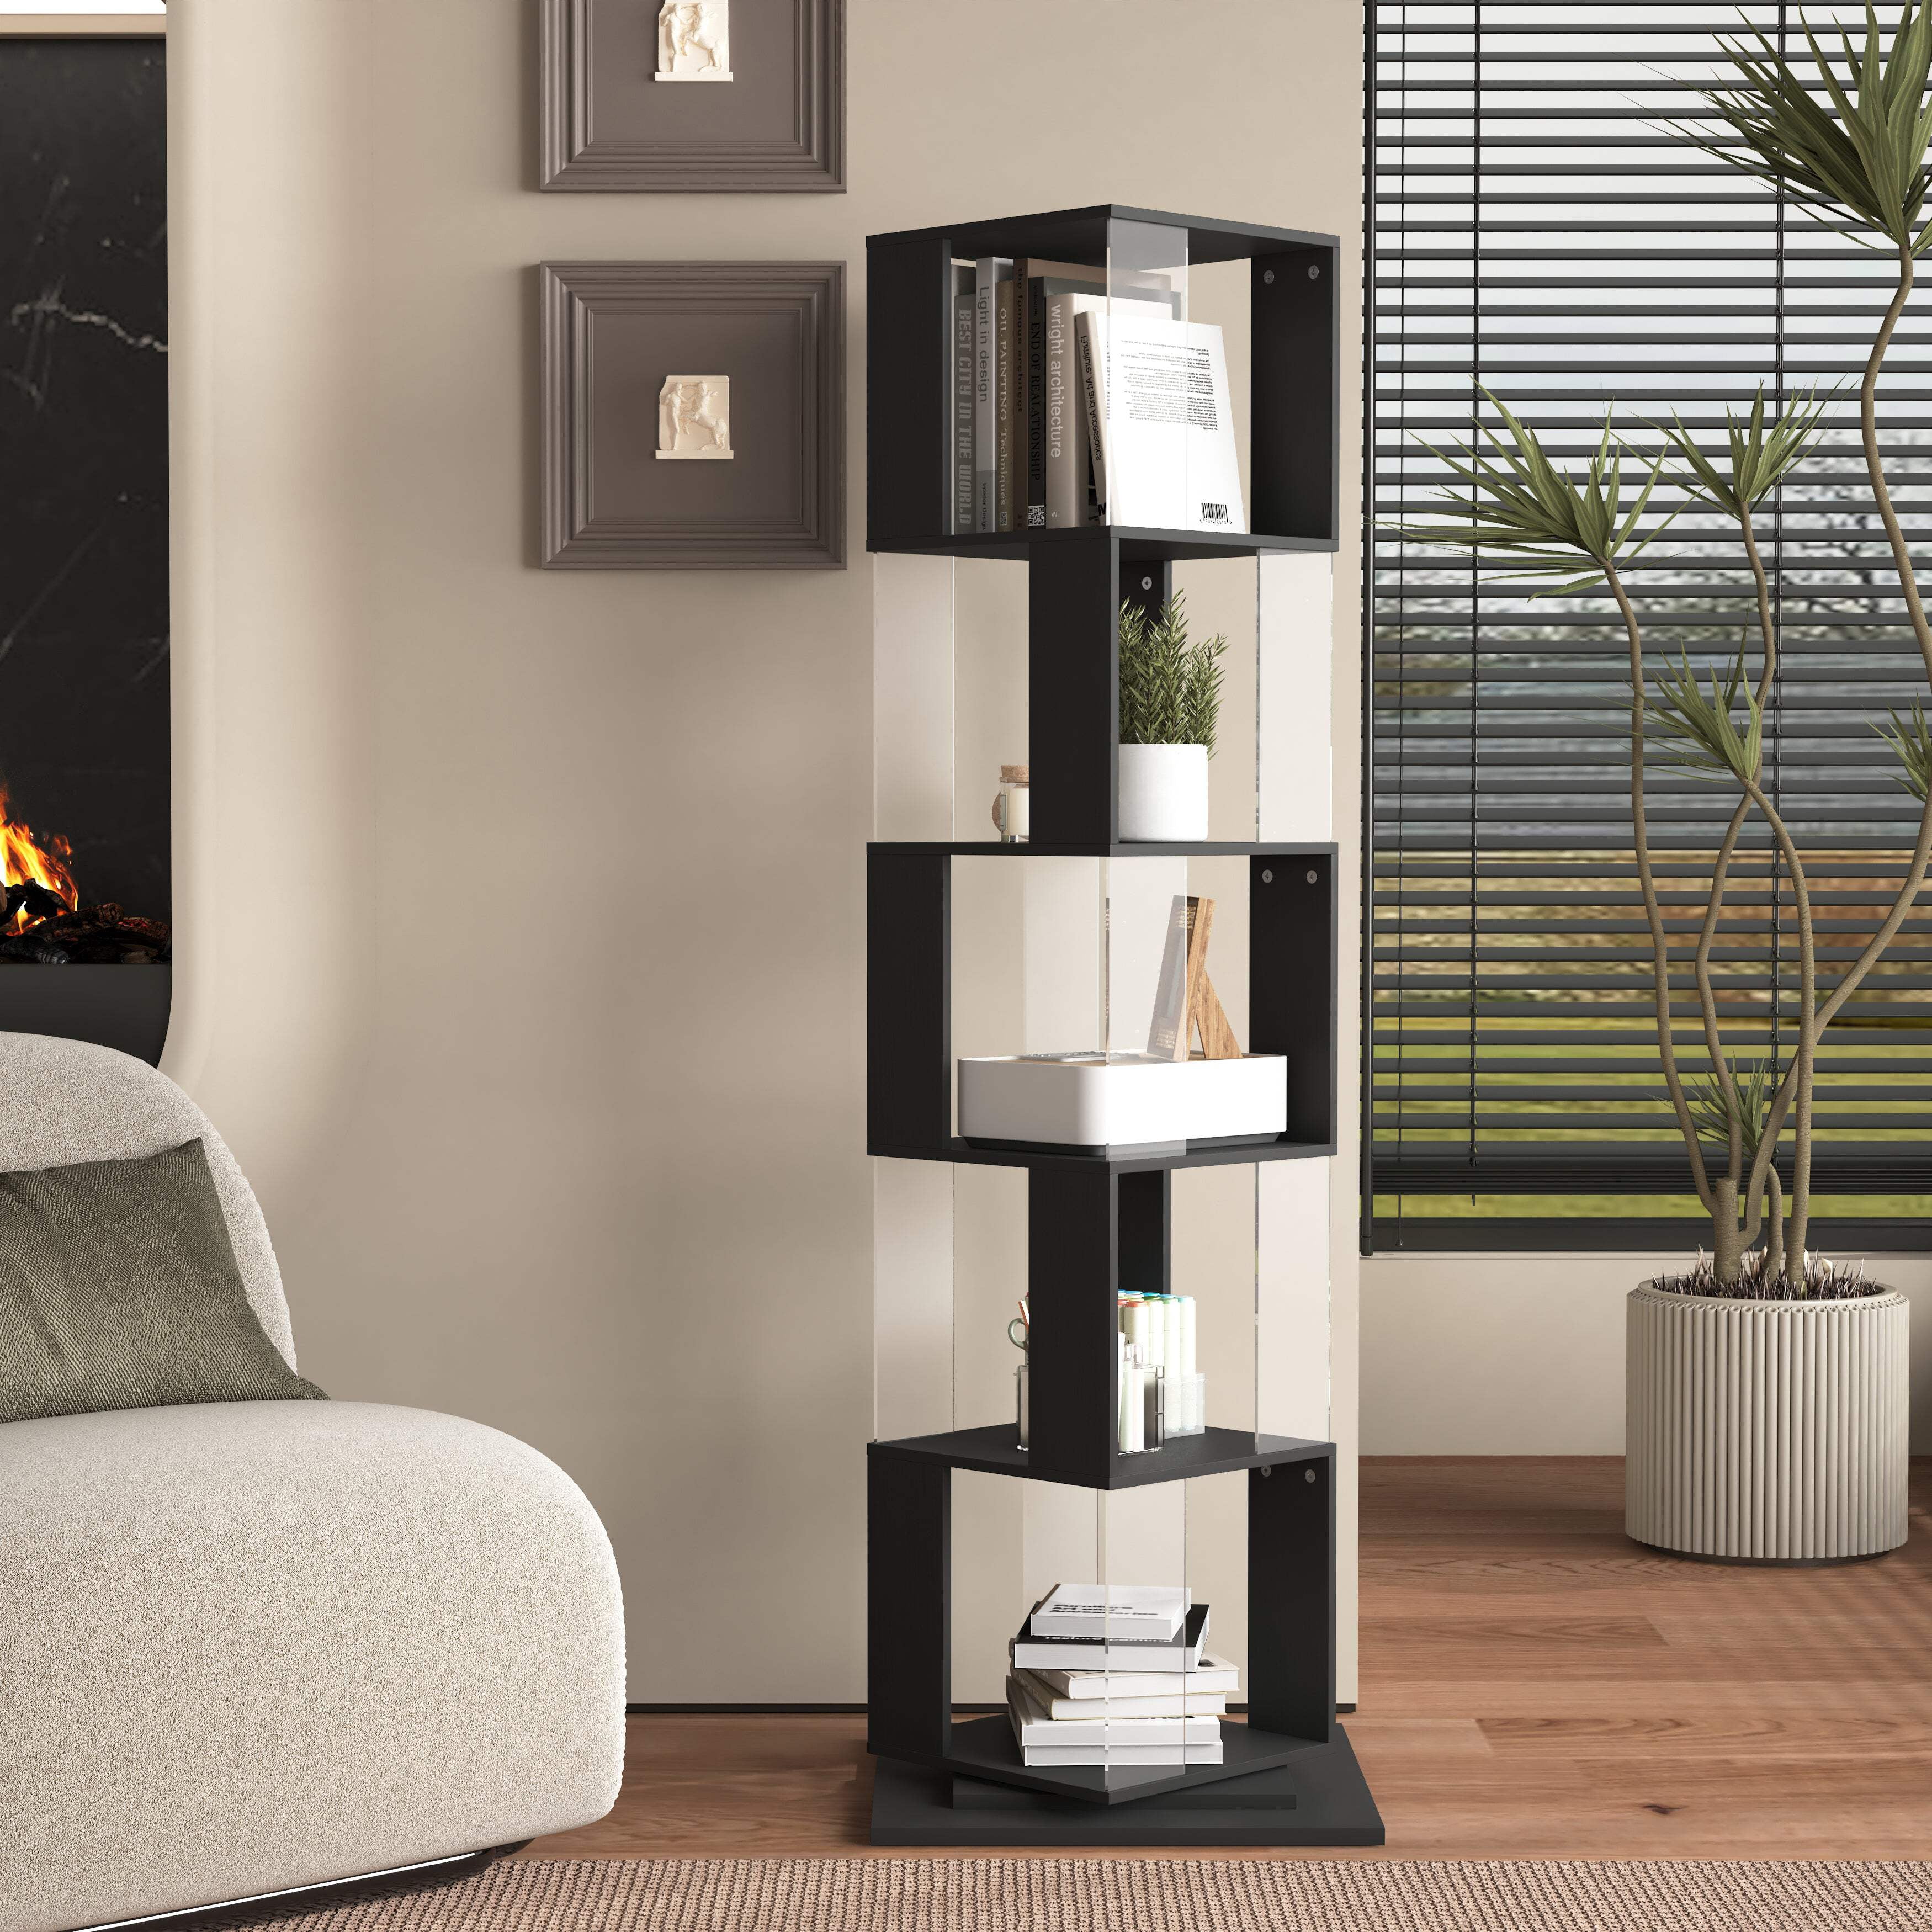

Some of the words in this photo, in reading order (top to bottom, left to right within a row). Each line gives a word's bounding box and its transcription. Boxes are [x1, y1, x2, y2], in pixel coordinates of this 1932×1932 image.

[978, 286, 989, 325] Light
[959, 309, 972, 351] BEST
[980, 331, 989, 344] in
[1031, 322, 1041, 350] END
[1049, 304, 1065, 355] wright
[959, 357, 972, 396] CITY
[978, 350, 989, 402] design
[1031, 354, 1041, 371] OF
[1031, 375, 1041, 481] REALATIONSHIP
[1050, 360, 1065, 458] architecture
[959, 426, 972, 459] THE
[959, 464, 972, 524] WORLD
